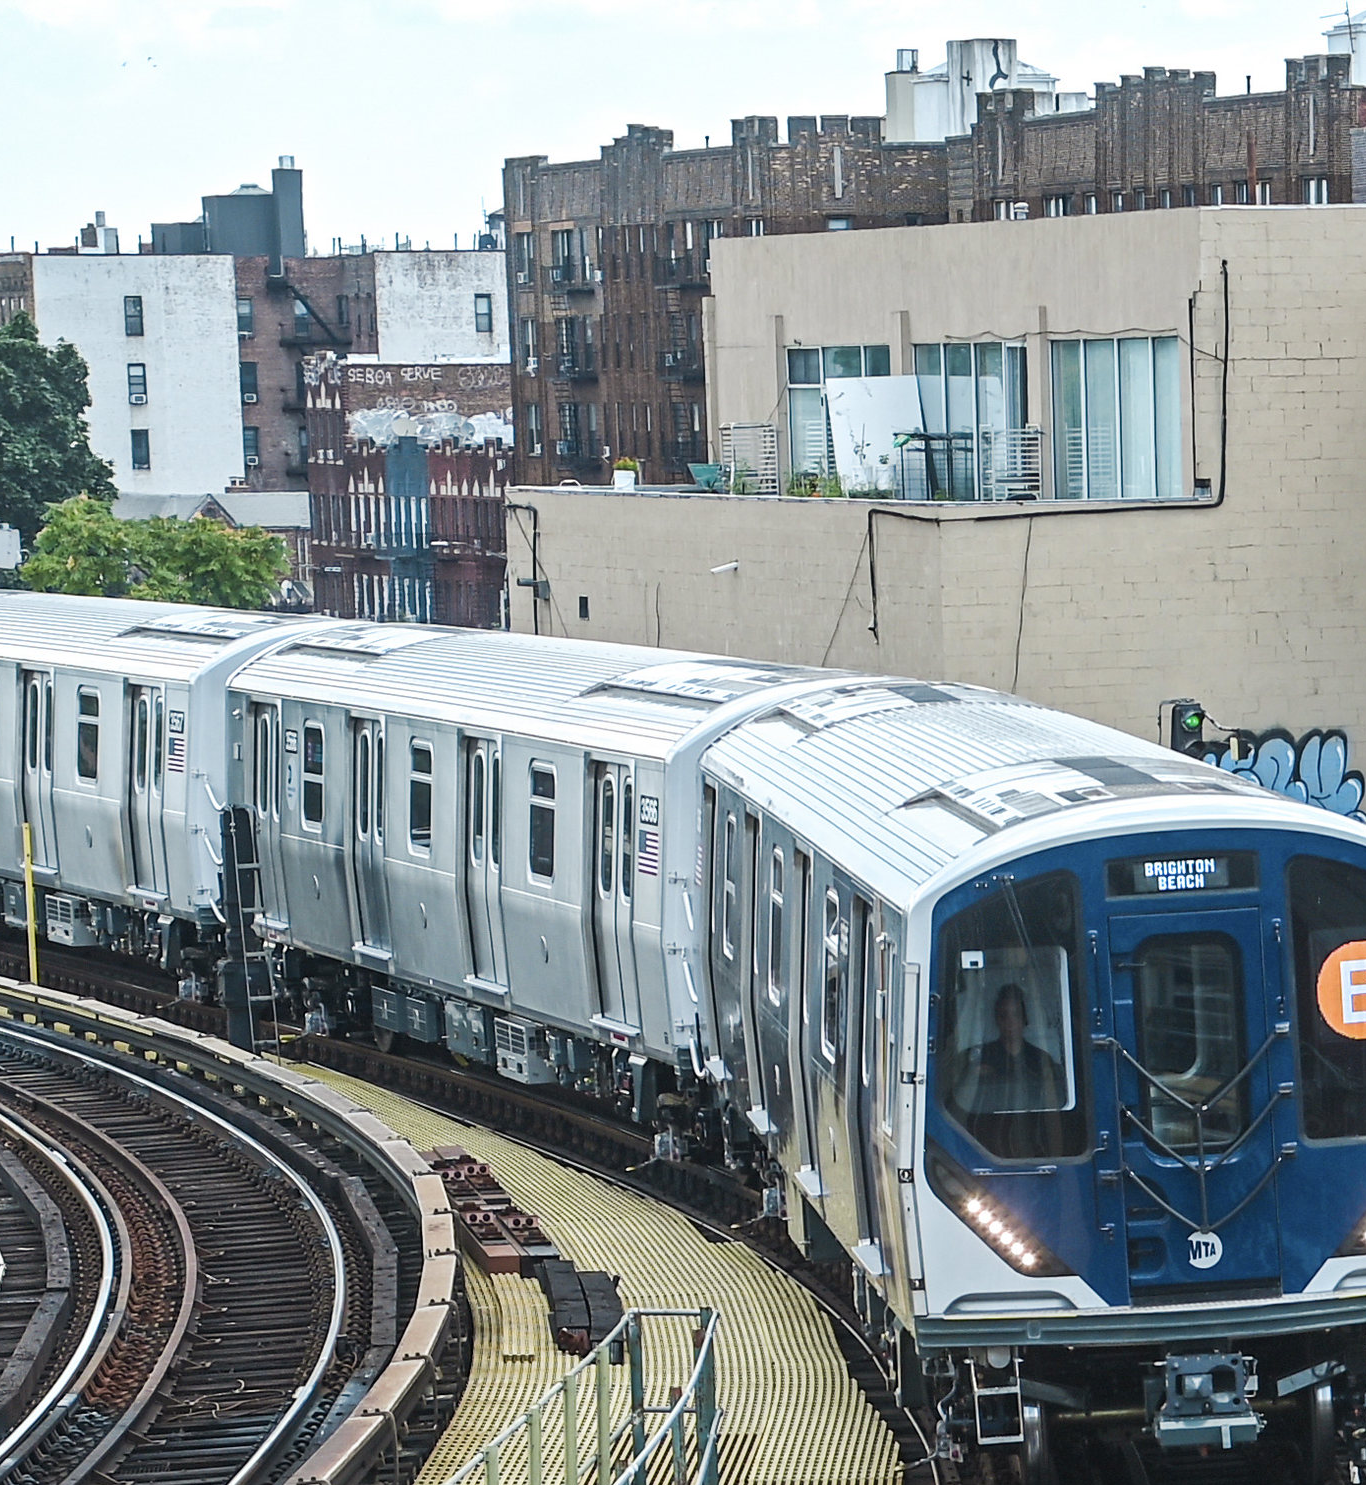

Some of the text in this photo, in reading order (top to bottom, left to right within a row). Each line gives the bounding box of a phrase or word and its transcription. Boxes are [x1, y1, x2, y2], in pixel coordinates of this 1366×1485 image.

[1144, 858, 1215, 877] BRIGHTON
[1158, 874, 1205, 891] BEACH
[1188, 1239, 1216, 1260] MTA
